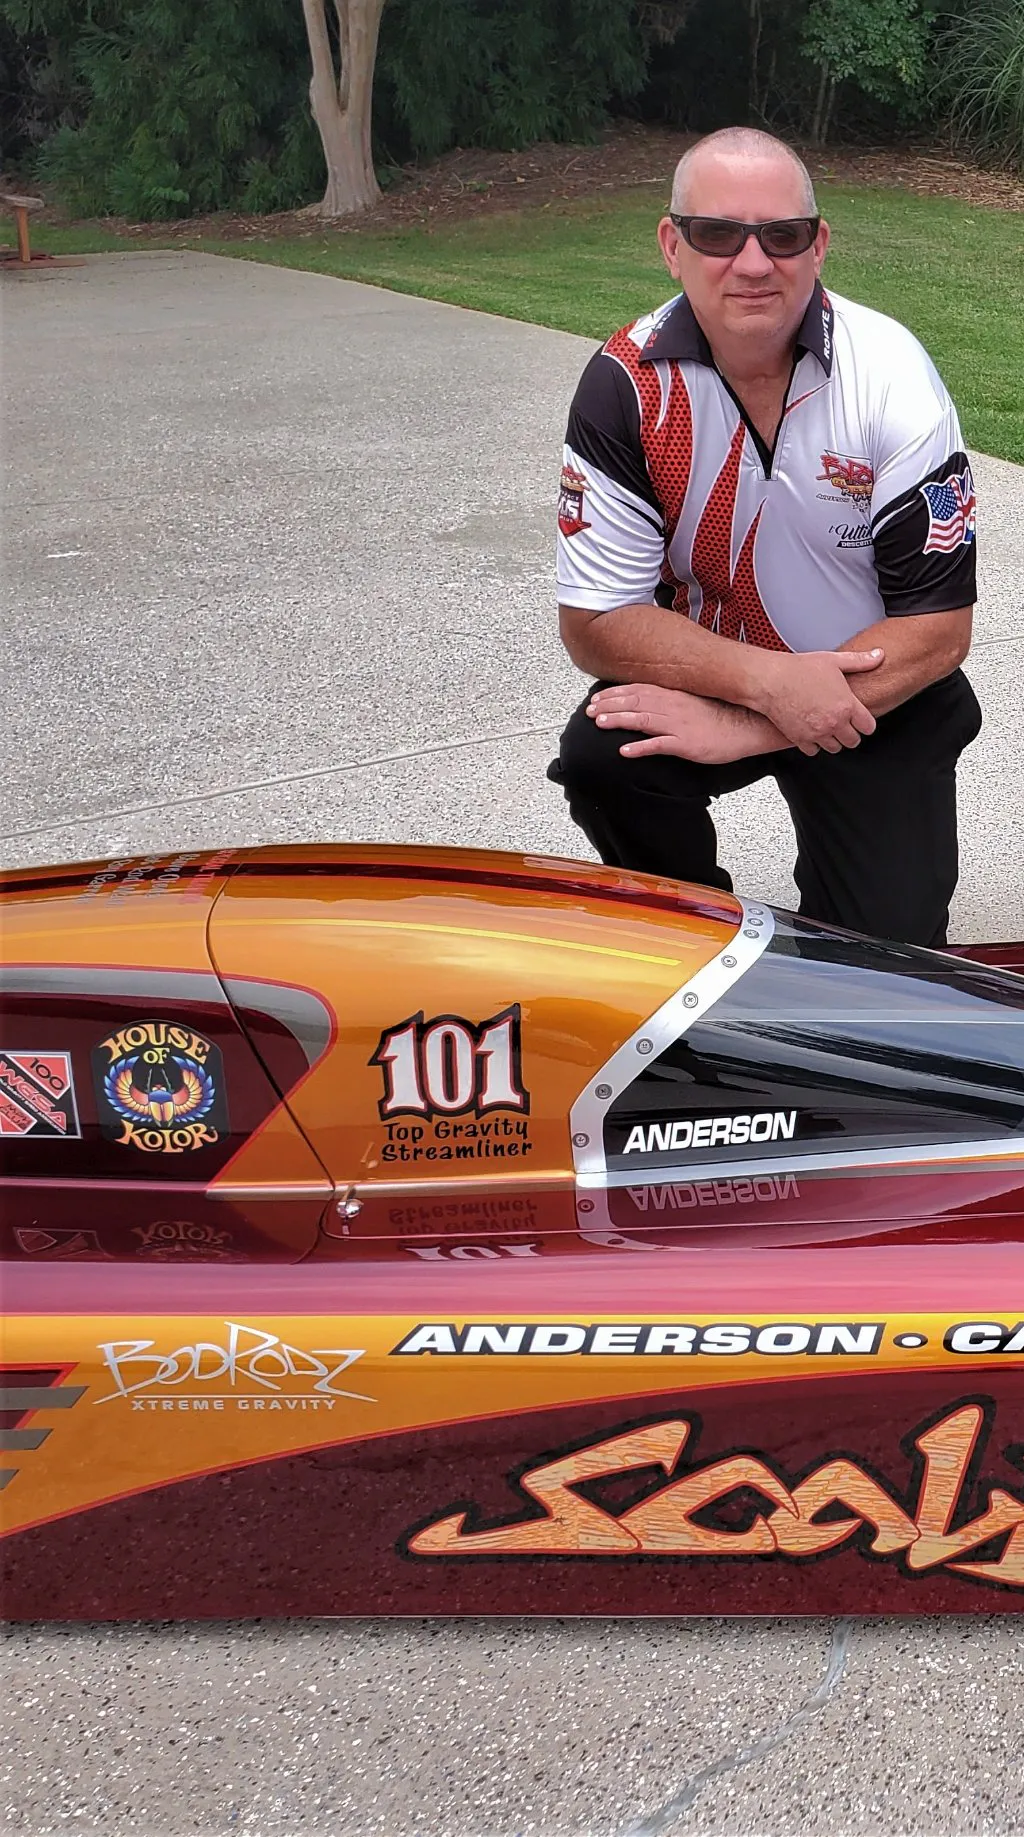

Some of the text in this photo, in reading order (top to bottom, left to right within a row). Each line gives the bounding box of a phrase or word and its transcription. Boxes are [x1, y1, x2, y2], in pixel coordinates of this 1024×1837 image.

[822, 310, 830, 360] ROUTE
[98, 1023, 211, 1064] HOUSE
[143, 1047, 170, 1064] OF
[30, 1057, 64, 1091] 100
[368, 1003, 530, 1122] 101
[115, 1119, 219, 1153] KOLOR
[384, 1117, 528, 1143] Top Gravity
[622, 1110, 797, 1154] ANDERSON
[381, 1139, 532, 1162] Streamliner
[390, 1321, 886, 1356] ANDERSON
[131, 1399, 337, 1411] XTREME GRAVITY
